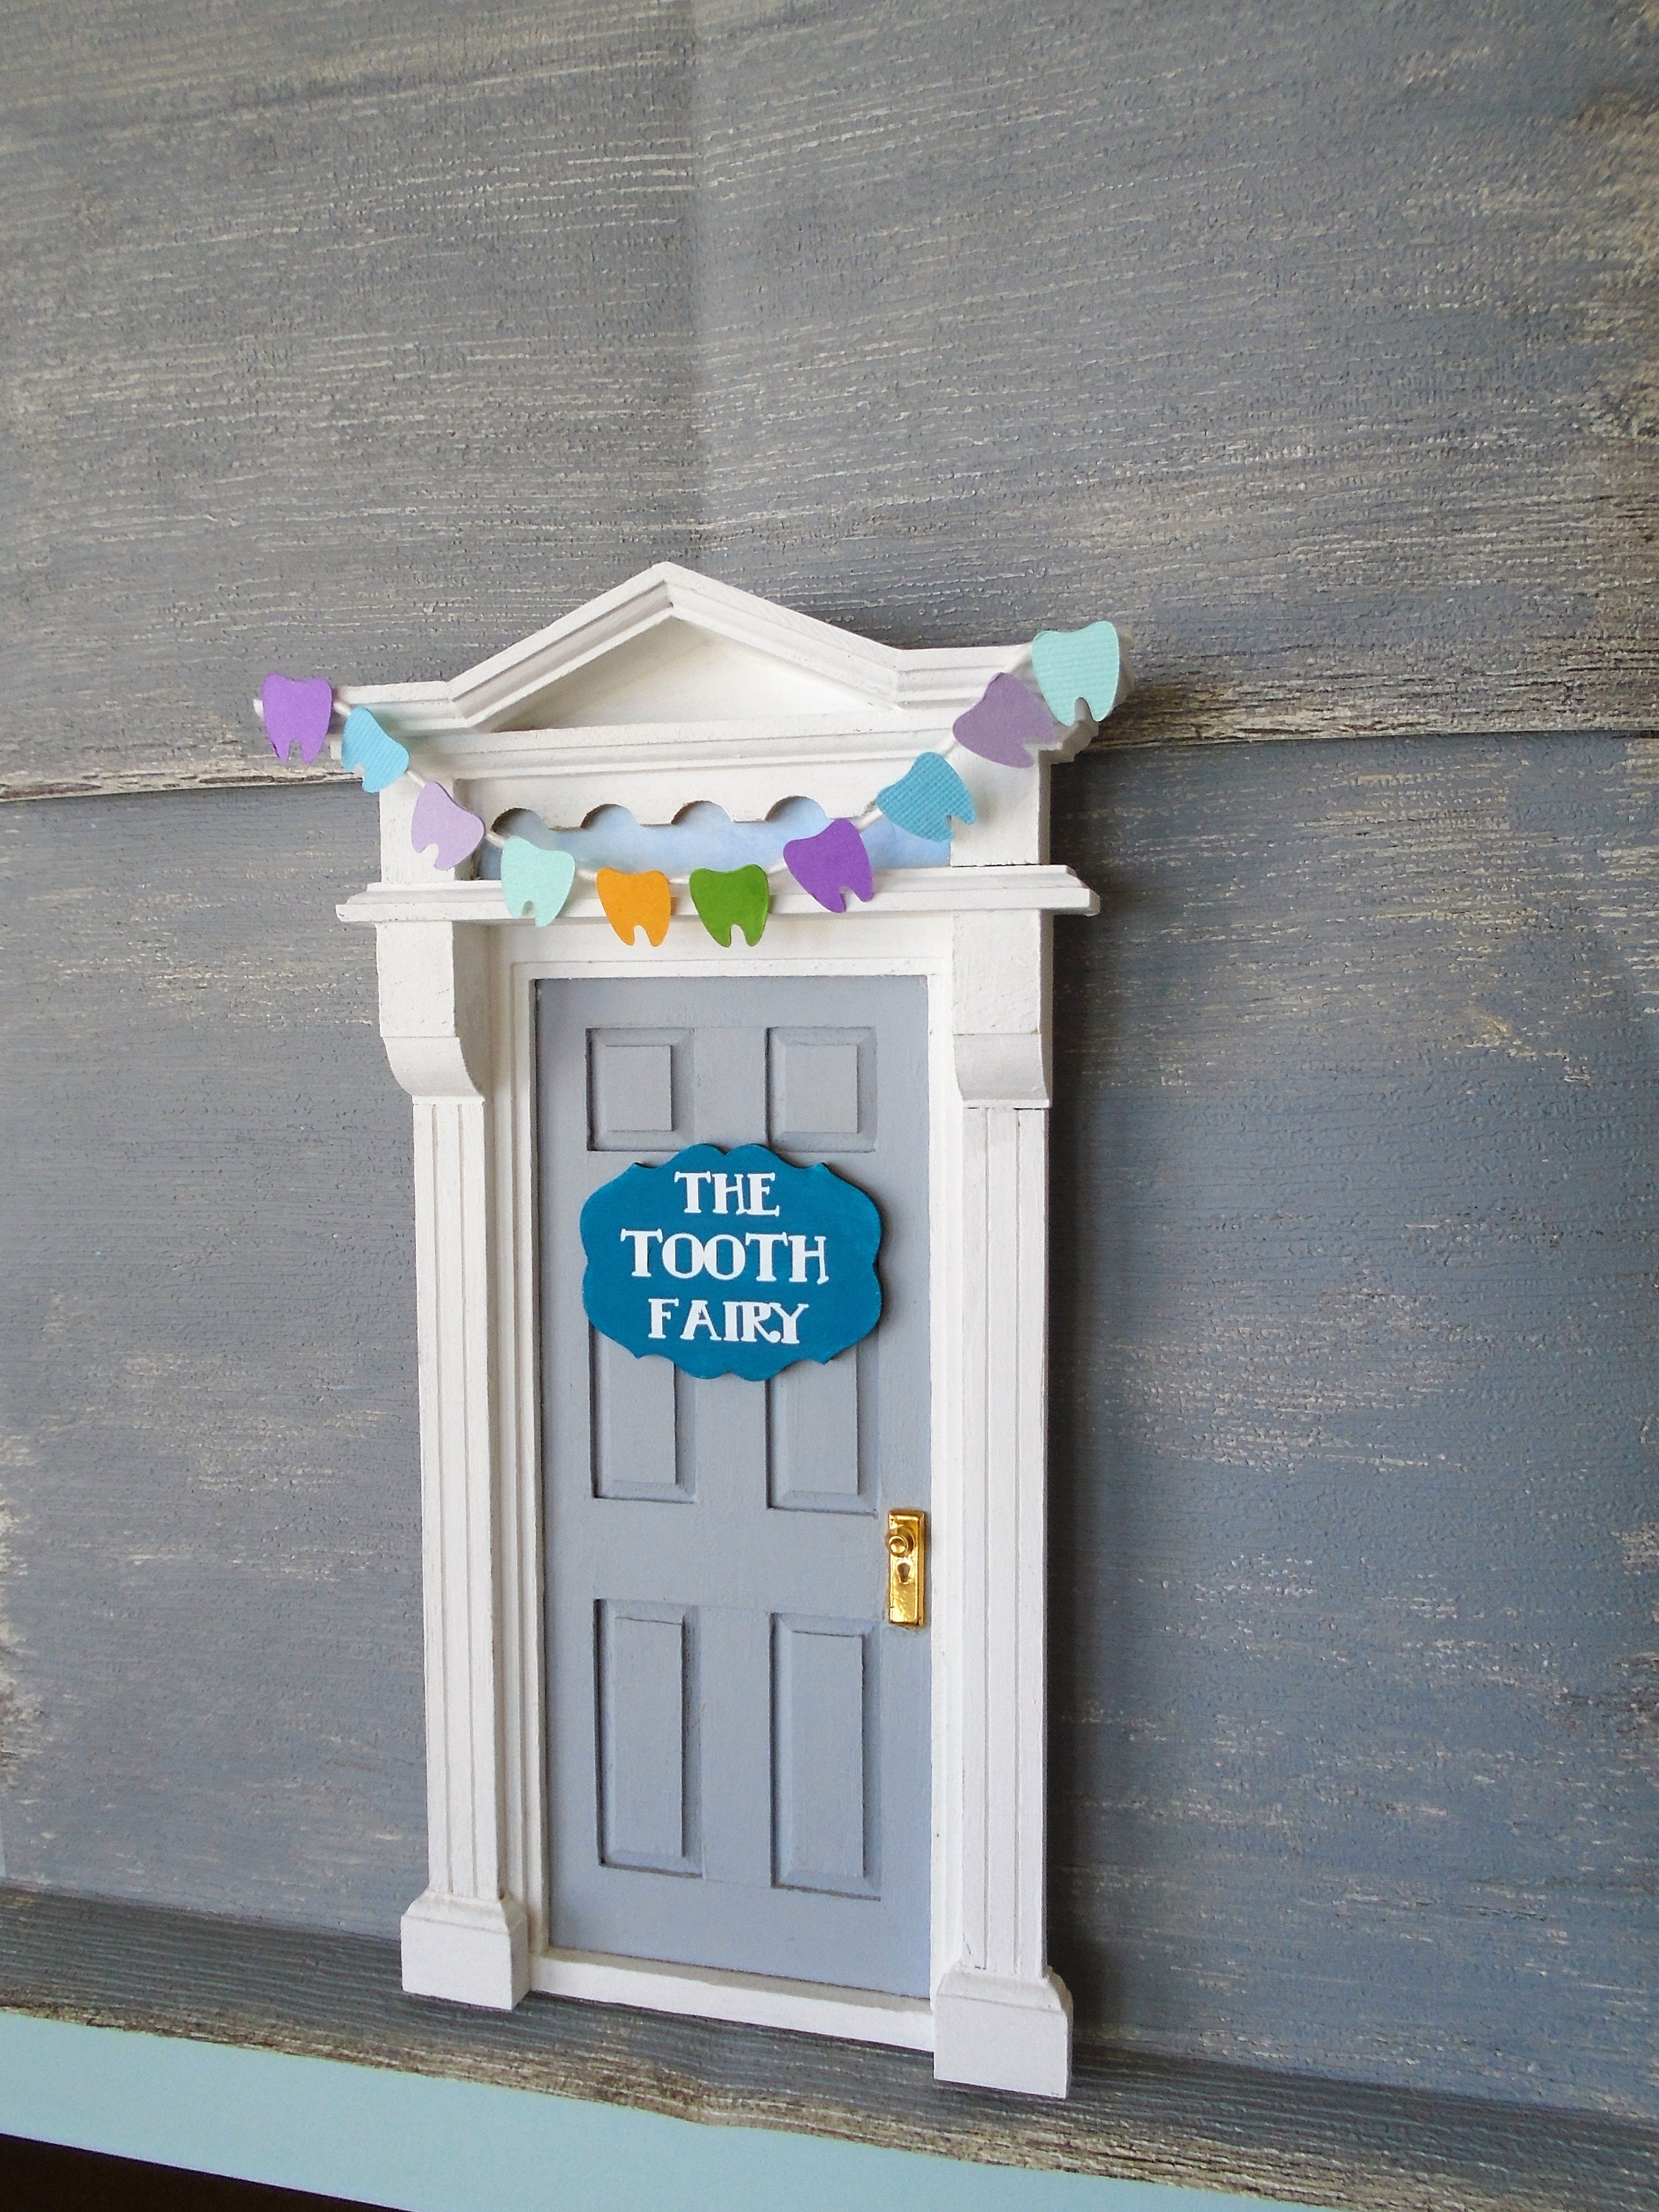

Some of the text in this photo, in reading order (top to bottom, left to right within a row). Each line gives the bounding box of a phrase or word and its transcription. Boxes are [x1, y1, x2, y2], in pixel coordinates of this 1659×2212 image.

[674, 1171, 779, 1217] THE
[620, 1228, 830, 1284] TOOTH
[647, 1298, 809, 1344] FAIRY
